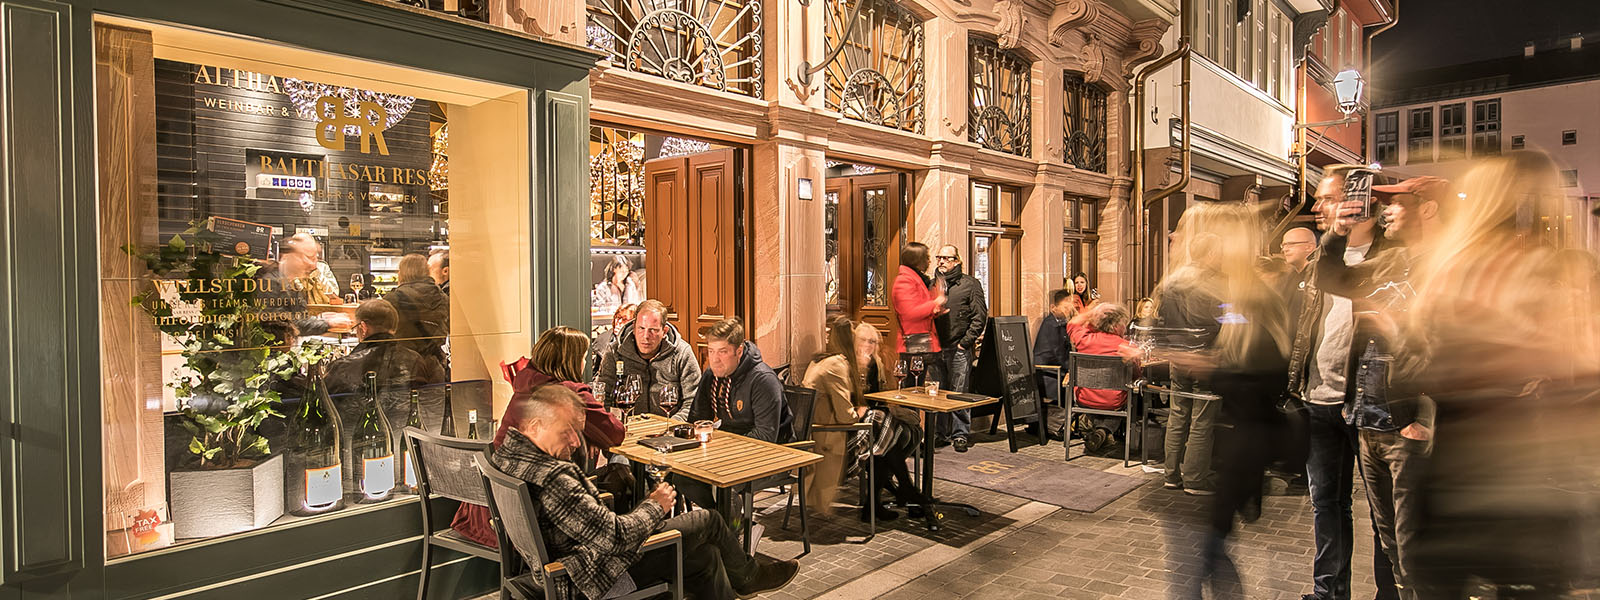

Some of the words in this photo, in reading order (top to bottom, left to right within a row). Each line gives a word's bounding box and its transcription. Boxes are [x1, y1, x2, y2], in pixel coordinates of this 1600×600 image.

[204, 97, 274, 115] WEINBAR
[281, 107, 289, 117] &
[259, 155, 387, 184] BALTHASAR
[1347, 176, 1369, 191] 5.0
[348, 191, 355, 200] &
[152, 278, 237, 296] WILLST
[242, 278, 273, 292] DU
[212, 298, 248, 308] TEAMS
[136, 516, 157, 527] TAX
[135, 524, 153, 534] FREE
